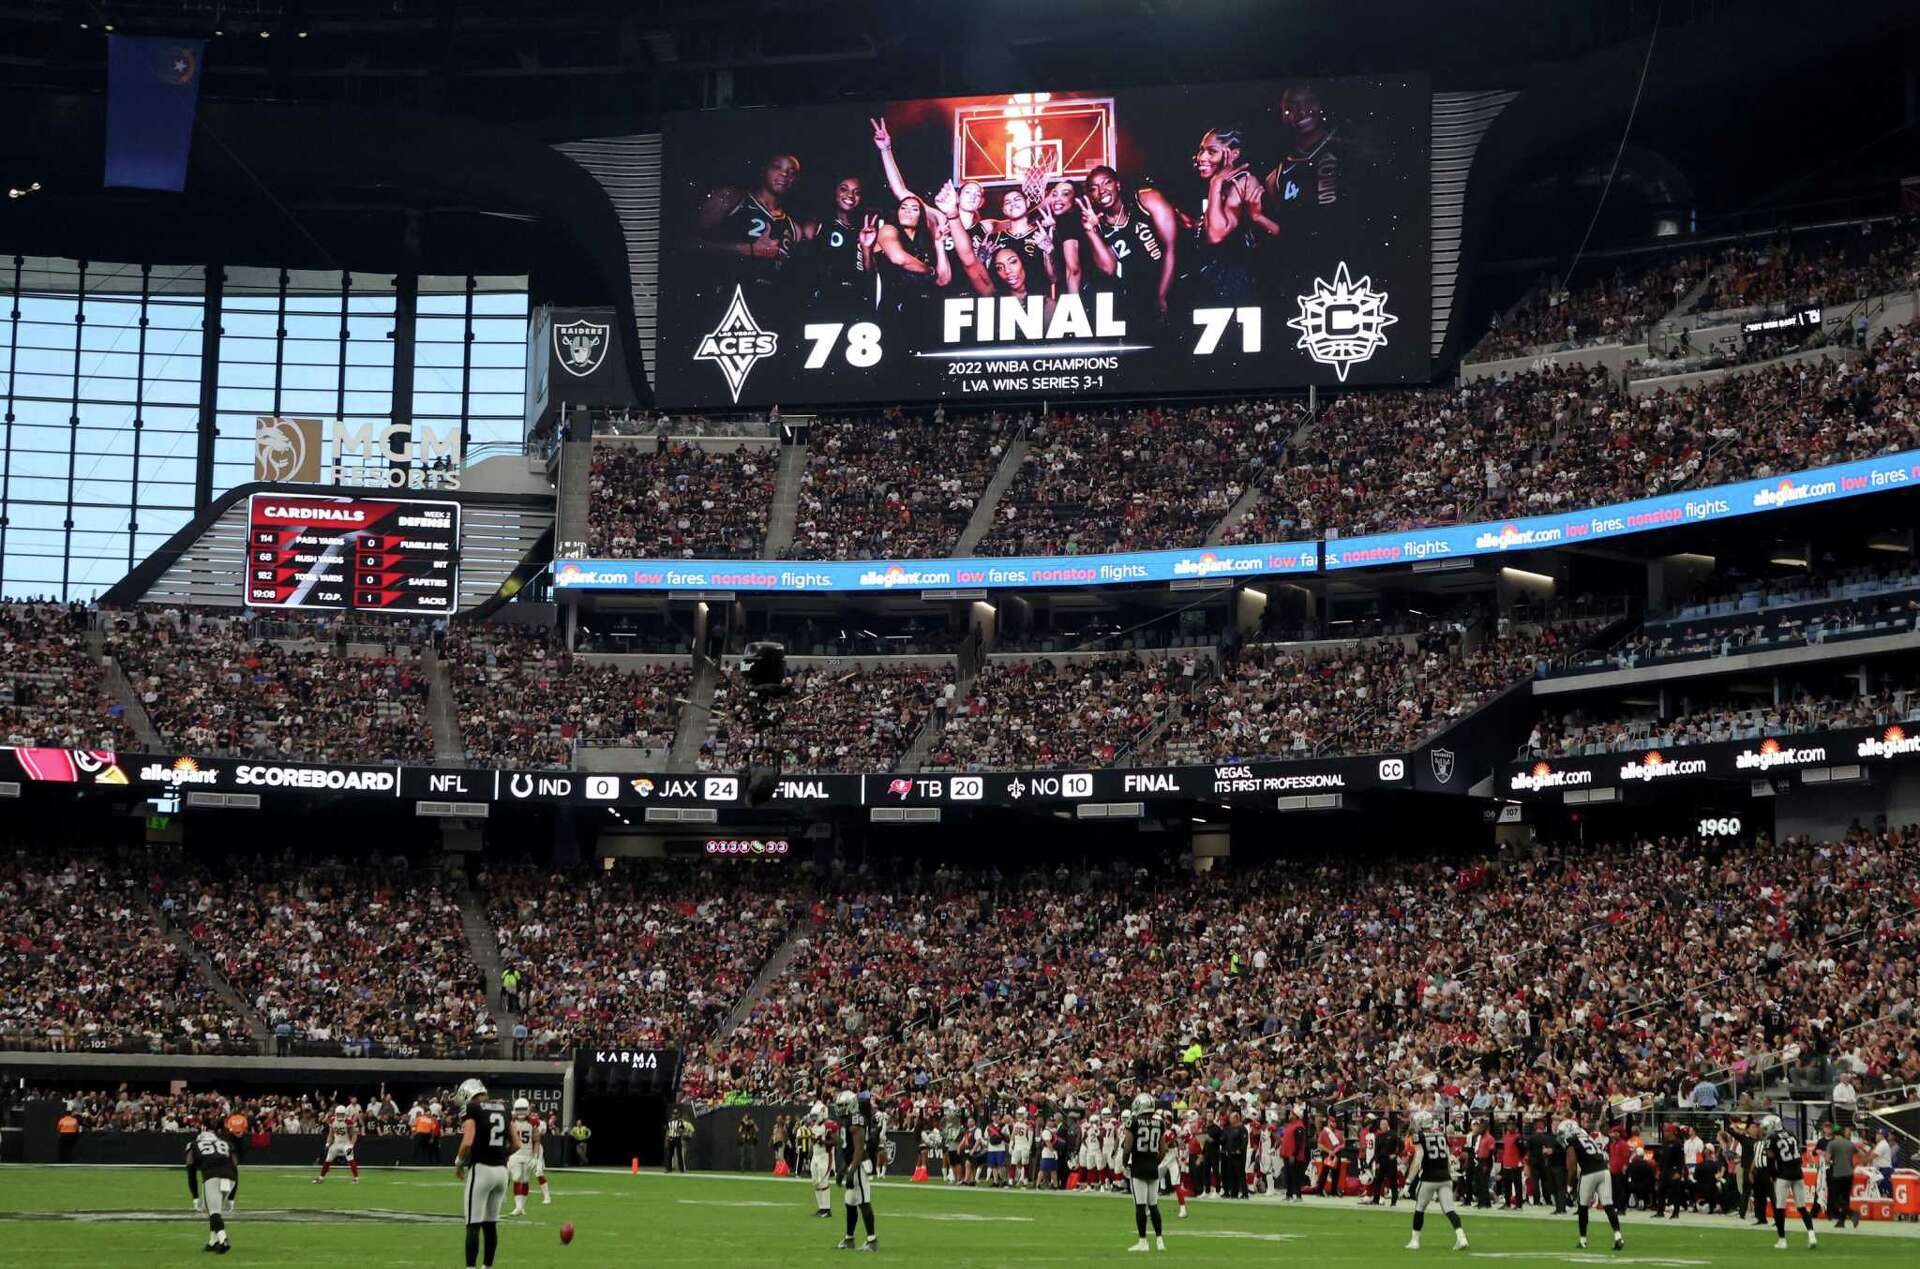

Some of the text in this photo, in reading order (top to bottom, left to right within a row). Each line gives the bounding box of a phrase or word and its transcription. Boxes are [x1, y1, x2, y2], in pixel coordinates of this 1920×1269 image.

[944, 292, 1126, 343] FINAL
[1193, 307, 1261, 354] 71
[701, 336, 775, 355] ACES
[804, 322, 882, 369] 78
[948, 357, 1119, 375] 2022 WNBA CHAMPIONS
[963, 375, 1104, 392] LVA WINS SERIES 3-1
[332, 421, 462, 465] MGM
[332, 466, 462, 491] RESORTS
[1753, 482, 1836, 508] allegiant.com
[1840, 475, 1868, 491] low
[1871, 469, 1909, 487] fares.
[264, 506, 365, 521] CARDINALS
[1475, 500, 1730, 550] allegiant.com low fares. nonstop flights.
[367, 539, 375, 547] 0
[367, 558, 374, 566] 0
[1173, 556, 1263, 576] allegiant.com
[1268, 554, 1296, 568] low
[1343, 545, 1400, 562] nonstop
[1404, 538, 1451, 558] flights.
[366, 576, 374, 584] 0
[634, 571, 663, 585] low
[667, 571, 707, 585] fares.
[711, 572, 776, 588] nonstop
[781, 571, 833, 588] flights.
[860, 564, 1149, 588] allegiant.com low fares. nonstop flights.
[1736, 745, 1826, 771] allegiant.com
[140, 763, 217, 785] allegiant
[235, 765, 394, 791] SCOREBOARD
[1214, 765, 1253, 779] VEGAS,
[1382, 763, 1401, 777] CC
[1620, 757, 1706, 781] allegiant.com
[429, 775, 468, 793] NFL
[538, 779, 572, 797] IND
[659, 779, 697, 798] JAX
[709, 781, 734, 797] 24
[916, 780, 980, 798] TB 20
[1031, 773, 1179, 796] NO 10 FINAL
[1214, 774, 1345, 793] ITS FIRST PROFESSIONAL
[1510, 768, 1592, 791] allegiant.com
[1506, 808, 1519, 817] 107
[91, 1040, 107, 1049] 102
[596, 1051, 657, 1063] KARMA
[489, 1112, 506, 1146] 2
[1137, 1127, 1161, 1152] 20
[1425, 1135, 1448, 1160] 59
[1896, 1184, 1908, 1204] G
[1860, 1204, 1869, 1216] G
[1882, 1206, 1890, 1217] G
